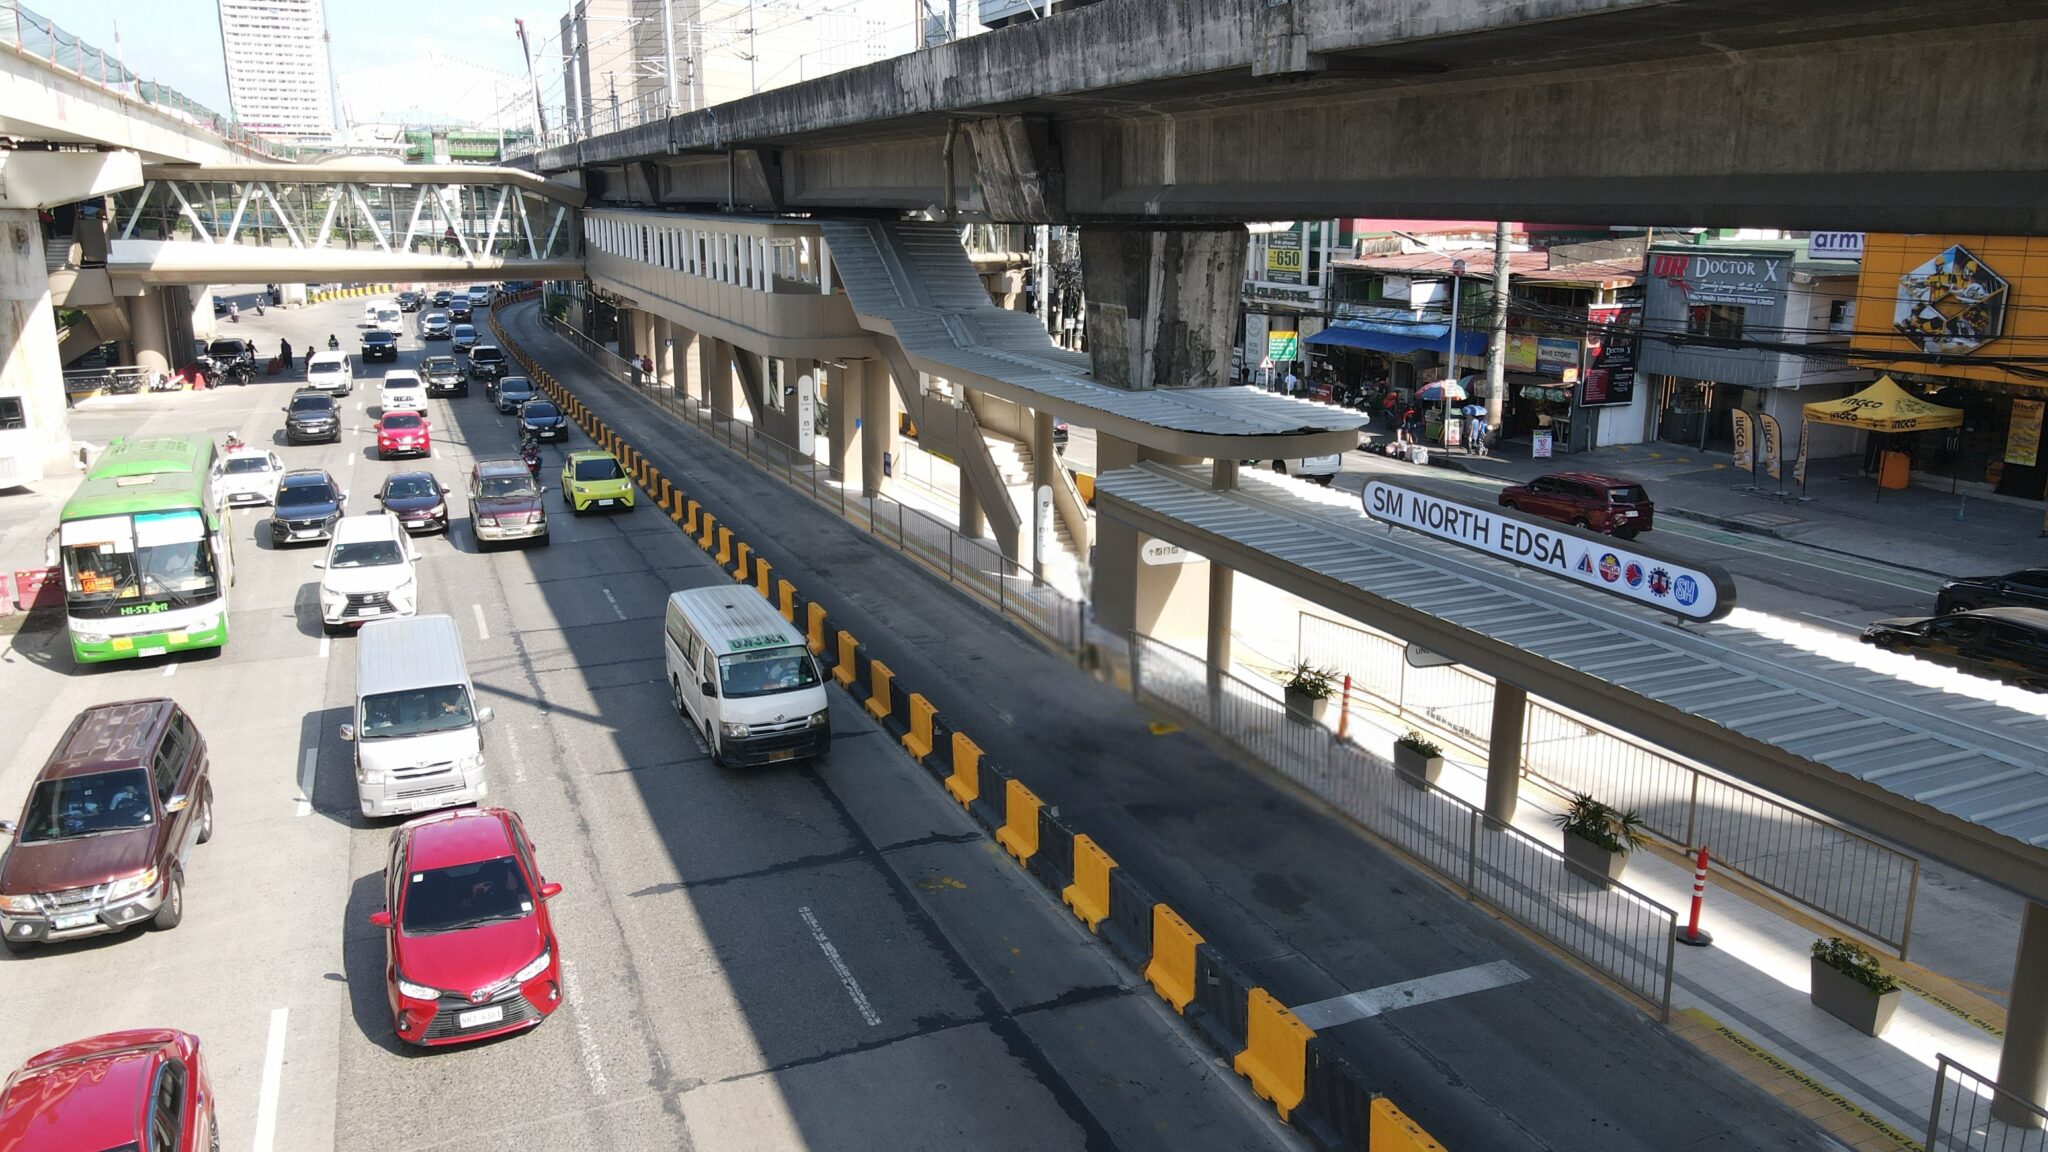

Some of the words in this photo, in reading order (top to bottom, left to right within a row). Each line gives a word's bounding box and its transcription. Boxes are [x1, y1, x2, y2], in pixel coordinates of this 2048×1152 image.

[1695, 257, 1756, 278] DOCTOR
[1764, 260, 1779, 282] X
[1373, 486, 1403, 518] SM
[1412, 497, 1489, 544] NORTH
[1500, 523, 1567, 569] EDSA
[1600, 563, 1619, 574] MMDA
[1898, 980, 1930, 997] Lane
[1929, 996, 1971, 1020] Yellow
[1716, 1026, 1757, 1052] Please
[1756, 1051, 1786, 1071] stay
[1785, 1069, 1835, 1098] behind
[1829, 1095, 1856, 1112] the
[1857, 1111, 1905, 1142] Yellow
[1902, 1140, 1927, 1152] La
